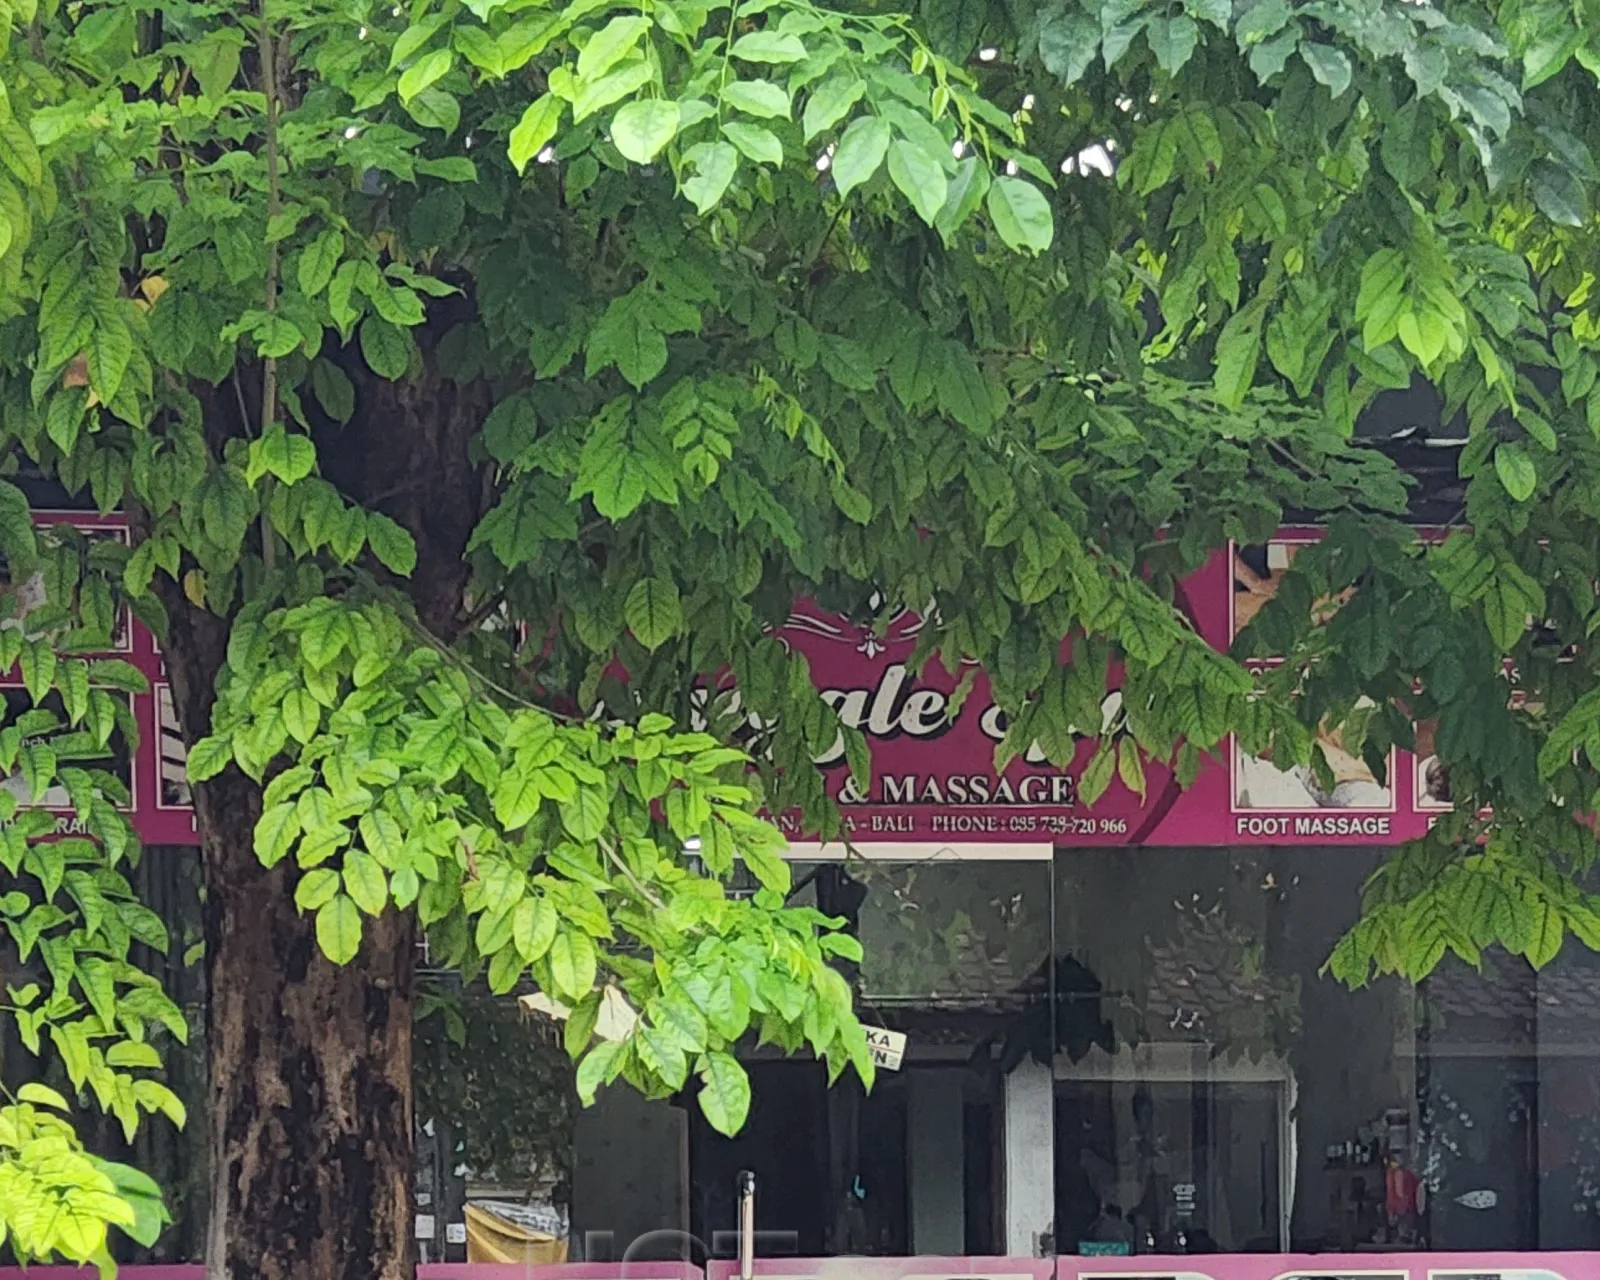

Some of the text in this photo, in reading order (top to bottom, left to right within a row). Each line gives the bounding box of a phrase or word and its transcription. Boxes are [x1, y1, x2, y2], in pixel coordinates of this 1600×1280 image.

[882, 775, 1074, 804] MASSAGE
[872, 815, 914, 832] BALI
[1236, 817, 1391, 835] FOOT MASSAGE
